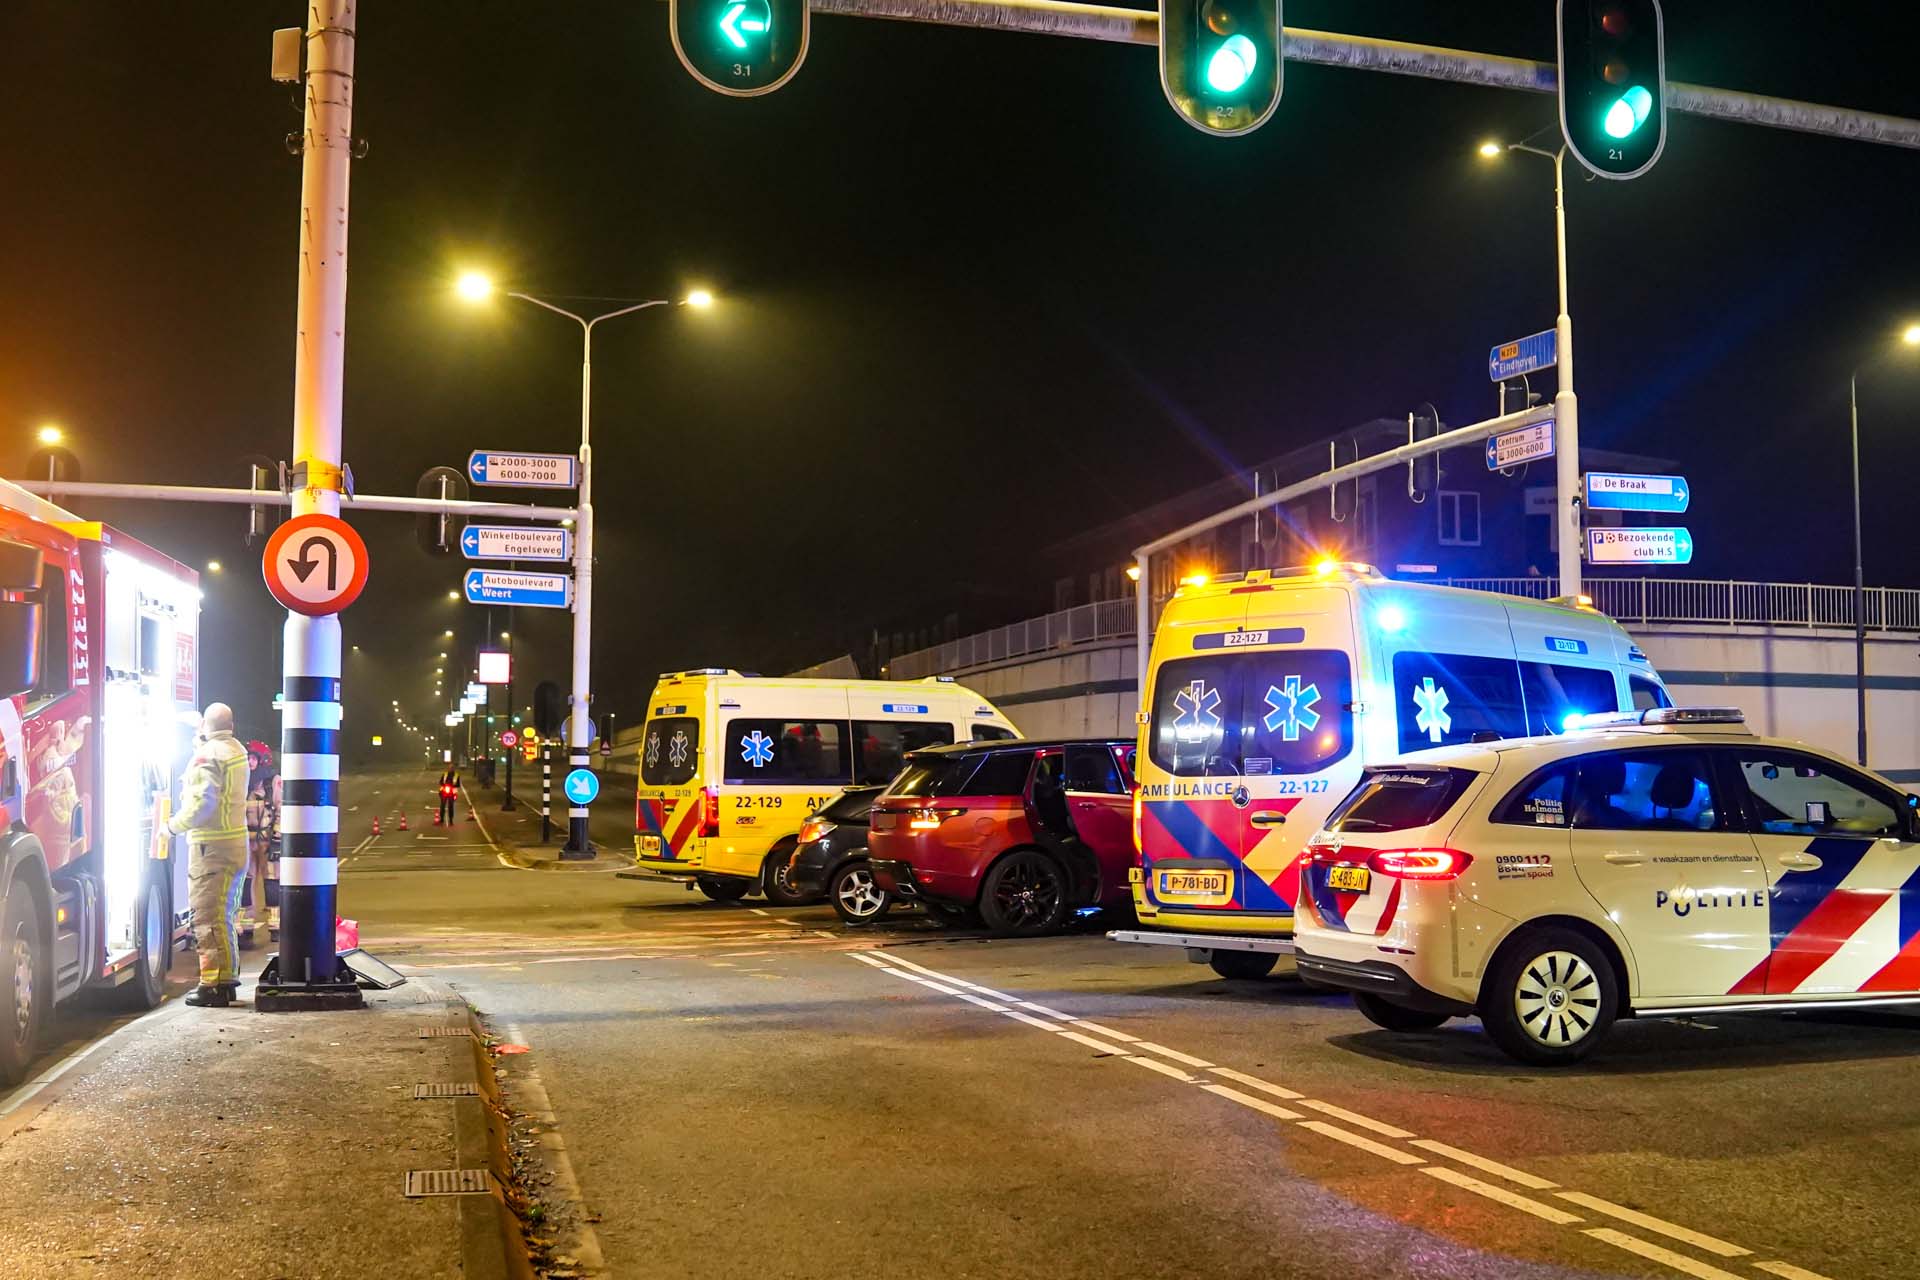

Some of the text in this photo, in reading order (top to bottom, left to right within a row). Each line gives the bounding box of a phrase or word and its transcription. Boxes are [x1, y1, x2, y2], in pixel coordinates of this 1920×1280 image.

[733, 64, 751, 77] 3.1
[1216, 106, 1234, 117] 2.2
[1609, 149, 1623, 161] 2.1
[1500, 355, 1537, 373] Eindhoven
[1498, 434, 1525, 447] Centrum
[501, 458, 557, 468] 2000-3000
[501, 470, 557, 480] 6000-7000
[1604, 478, 1647, 489] De Braak
[480, 531, 562, 541] Winkelboulevard
[1618, 533, 1674, 542] Bezoekende
[505, 544, 562, 555] Engelseweg
[1634, 548, 1654, 556] club
[485, 576, 553, 587] Autoboulevard
[482, 588, 512, 598] Weert
[69, 568, 90, 686] 22-3231
[1230, 632, 1263, 644] 22-127
[1142, 782, 1233, 797] AMBULANCE
[1279, 779, 1329, 794] 22-127
[736, 796, 782, 808] 22-129
[1534, 799, 1562, 807] Politie
[1524, 805, 1563, 813] Helmond
[1496, 855, 1523, 863] 0900
[1713, 854, 1753, 862] dienstbaar
[1172, 876, 1218, 889] P-781-BD
[1331, 870, 1364, 886] S-483-JN
